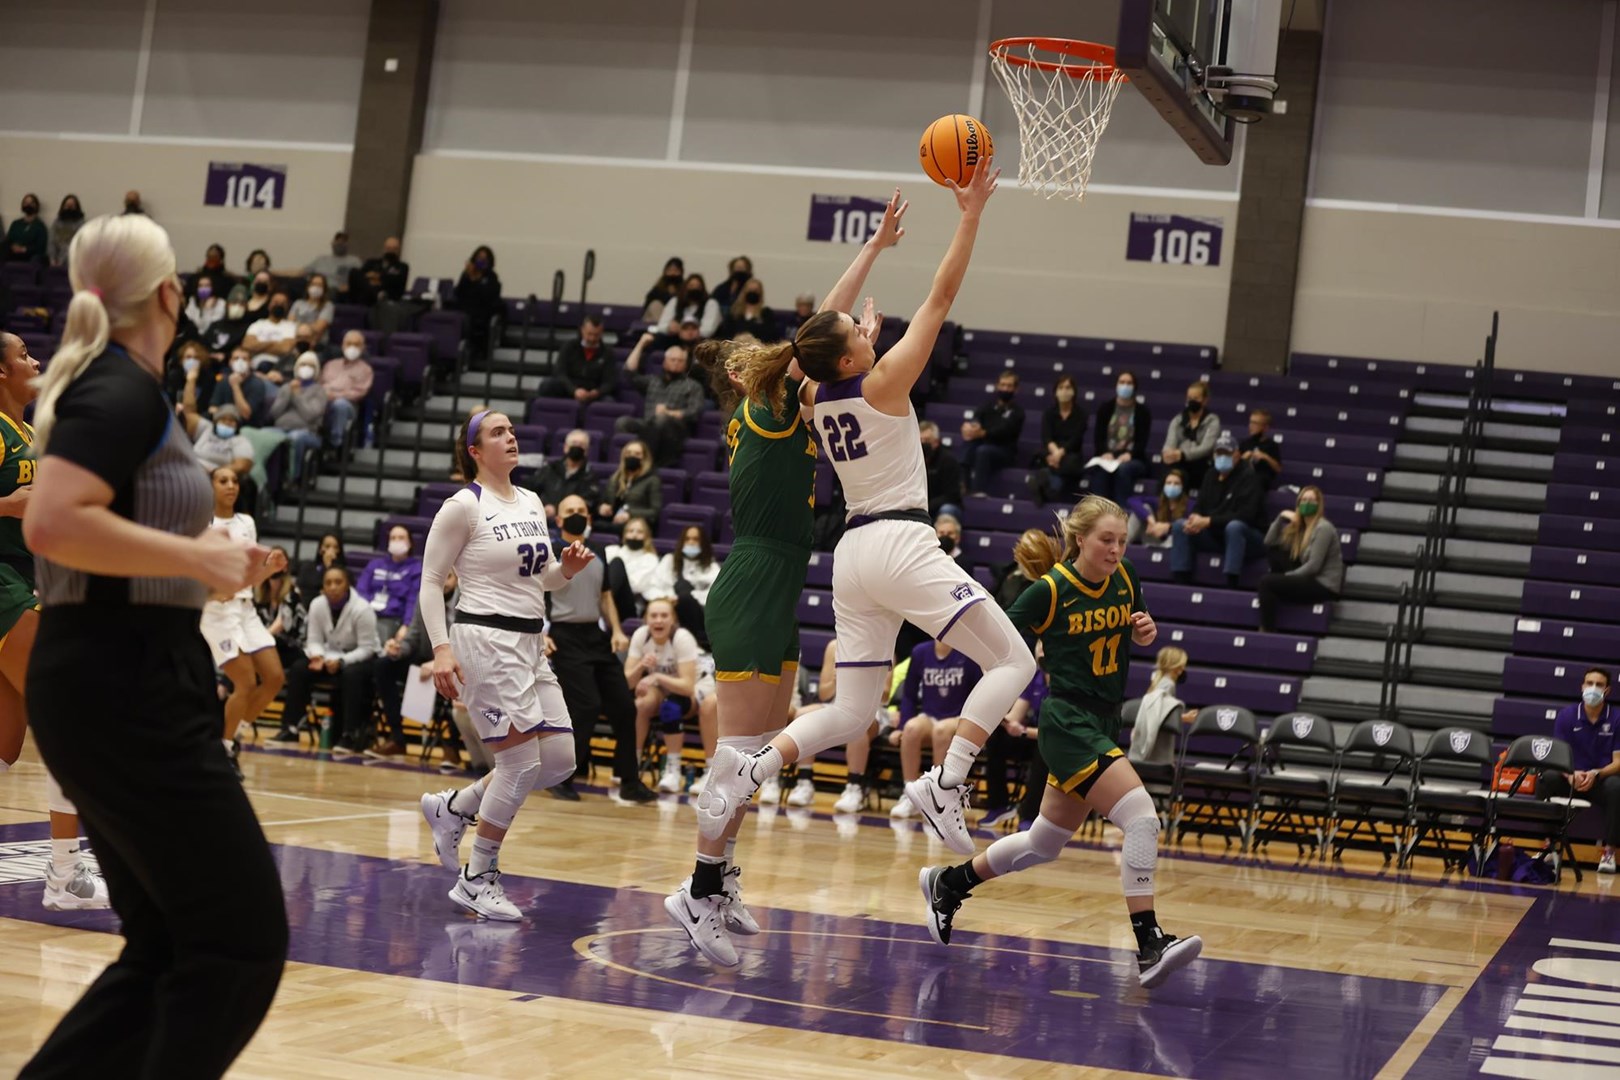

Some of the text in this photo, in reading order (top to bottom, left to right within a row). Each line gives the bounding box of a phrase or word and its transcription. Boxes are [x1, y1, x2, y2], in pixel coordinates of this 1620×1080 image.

[965, 120, 979, 166] Wilson
[223, 174, 276, 209] 104
[1151, 228, 1211, 266] 106
[822, 412, 869, 462] 22
[517, 542, 549, 577] 32
[1067, 603, 1132, 635] BISON
[1088, 633, 1121, 677] 11
